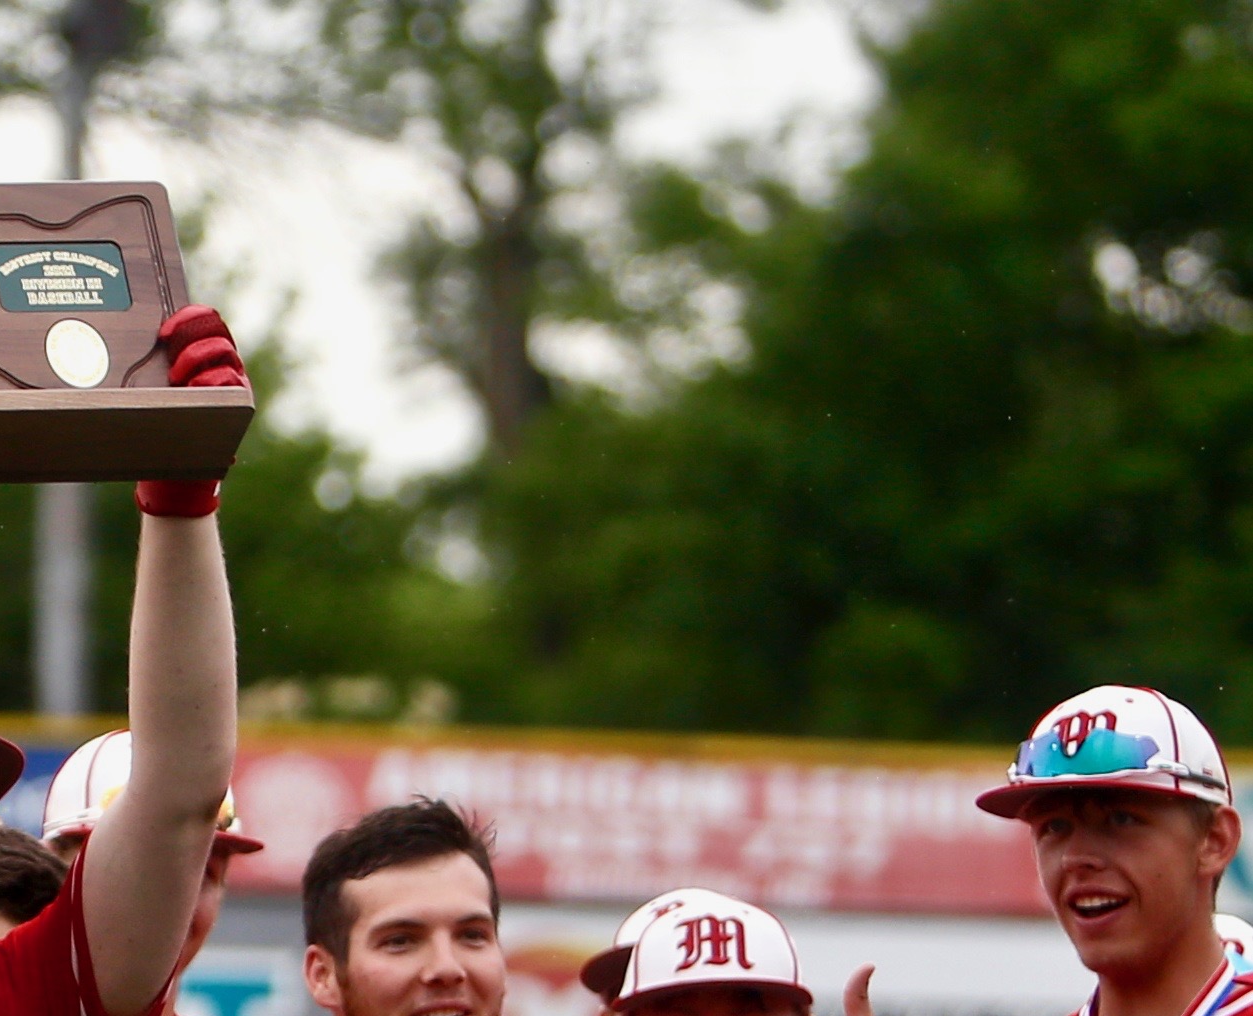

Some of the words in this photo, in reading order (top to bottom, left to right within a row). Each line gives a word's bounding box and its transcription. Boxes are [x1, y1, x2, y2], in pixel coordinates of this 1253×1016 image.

[21, 278, 85, 290] DIVISION
[27, 291, 103, 305] BASEBALL
[675, 884, 755, 972] M
